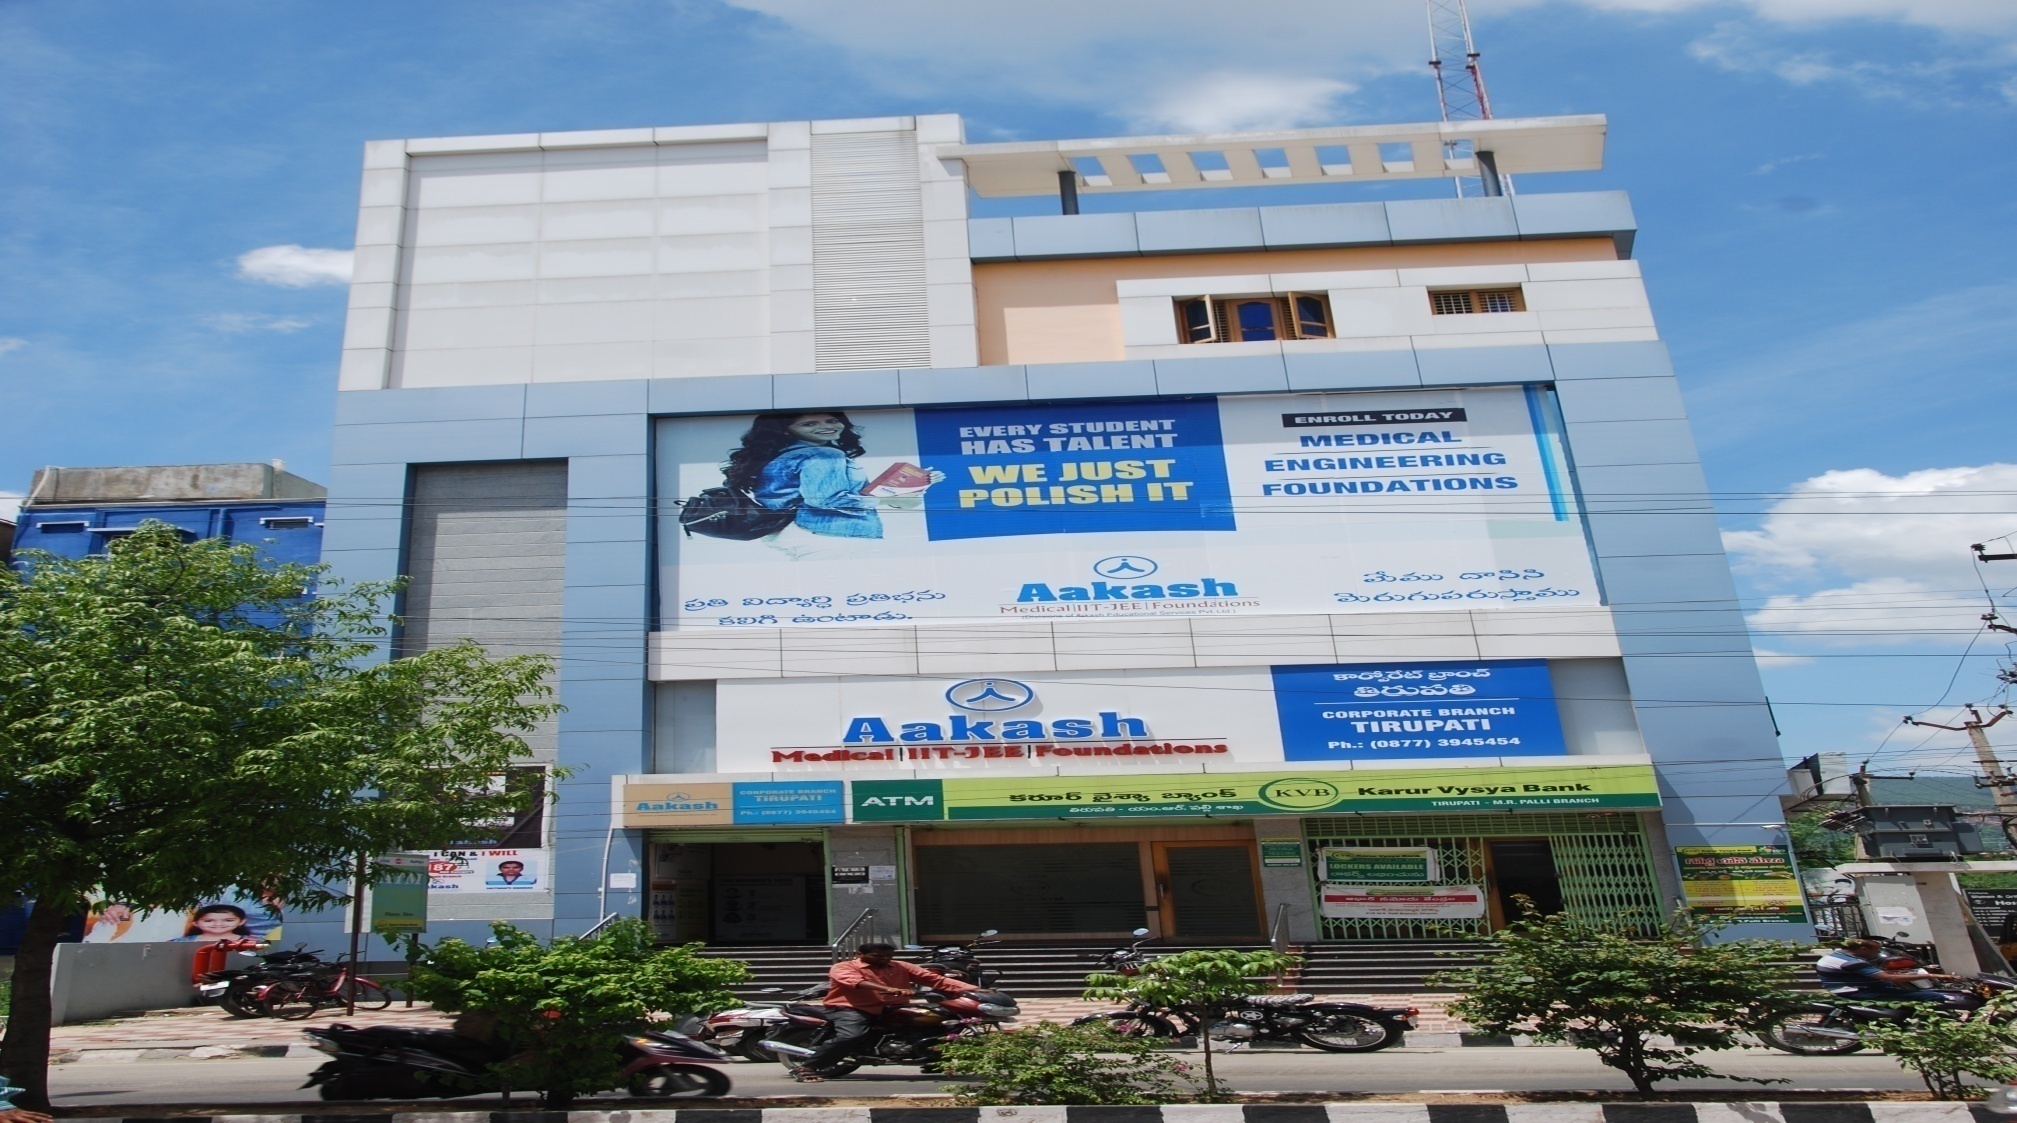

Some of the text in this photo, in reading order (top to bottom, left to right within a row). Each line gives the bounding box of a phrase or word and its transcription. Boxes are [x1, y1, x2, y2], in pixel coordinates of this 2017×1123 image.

[1294, 411, 1454, 425] ENROLL TODAY
[959, 419, 1176, 438] EVERY STUDENT
[961, 433, 1178, 455] HAS TALENT
[1300, 431, 1462, 448] MEDICAL
[1264, 453, 1507, 472] ENGINEERING
[968, 459, 1176, 485] WE JUST
[1262, 476, 1518, 496] FOUNDATIONS
[959, 482, 1194, 508] POLISH IT
[1363, 568, 1545, 583] మేము దానిని
[1016, 578, 1239, 602] Aakash
[684, 597, 729, 612] ప్రతి
[1000, 604, 1070, 614] Medical
[1153, 599, 1260, 611] Foundations
[1353, 683, 1476, 697] తిరుపతి
[1322, 707, 1515, 719] CORPORATE BRANCH
[843, 711, 1149, 743] Aakash
[1351, 718, 1491, 733] TIRUPATI
[1370, 739, 1431, 749] (0877)
[1438, 737, 1521, 747] 3945454
[771, 741, 1228, 763] Medical IIT-JEE Foundations
[1275, 787, 1332, 798] KVB
[1358, 782, 1593, 798] Karur Vysya Bank
[753, 794, 823, 803] TIRUPATI
[861, 795, 934, 807] ATM
[1553, 797, 1600, 805] BRANCH
[636, 801, 718, 812] Aakash
[488, 849, 518, 857] WILL
